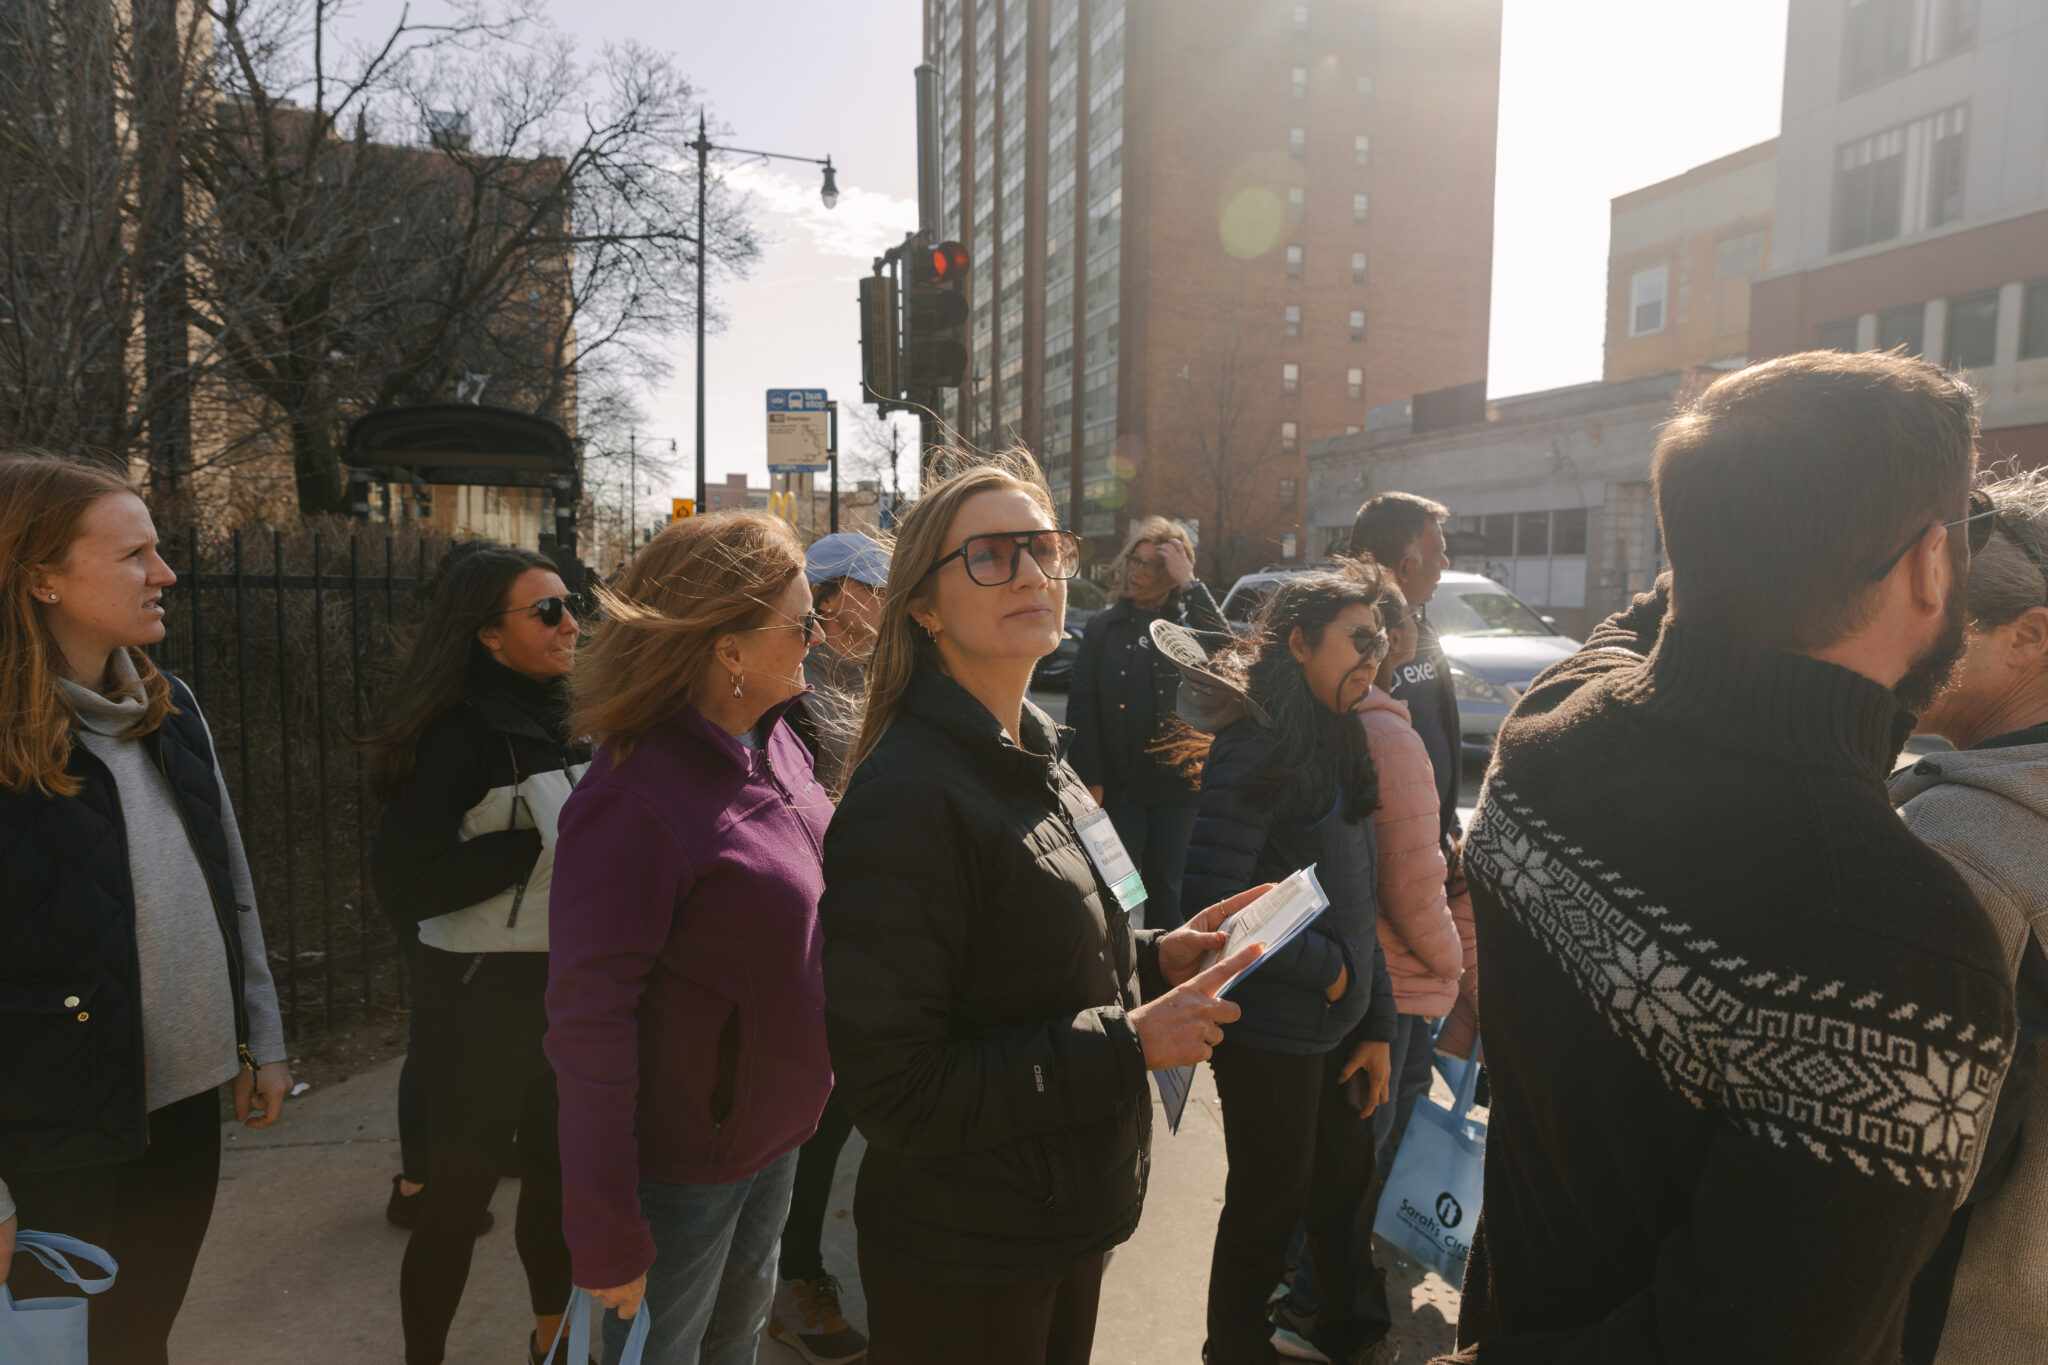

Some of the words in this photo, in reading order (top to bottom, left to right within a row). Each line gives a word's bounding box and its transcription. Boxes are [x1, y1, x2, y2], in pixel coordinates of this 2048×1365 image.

[805, 391, 822, 400] bus
[805, 401, 826, 410] stop
[1400, 1198, 1441, 1237] Sarah's
